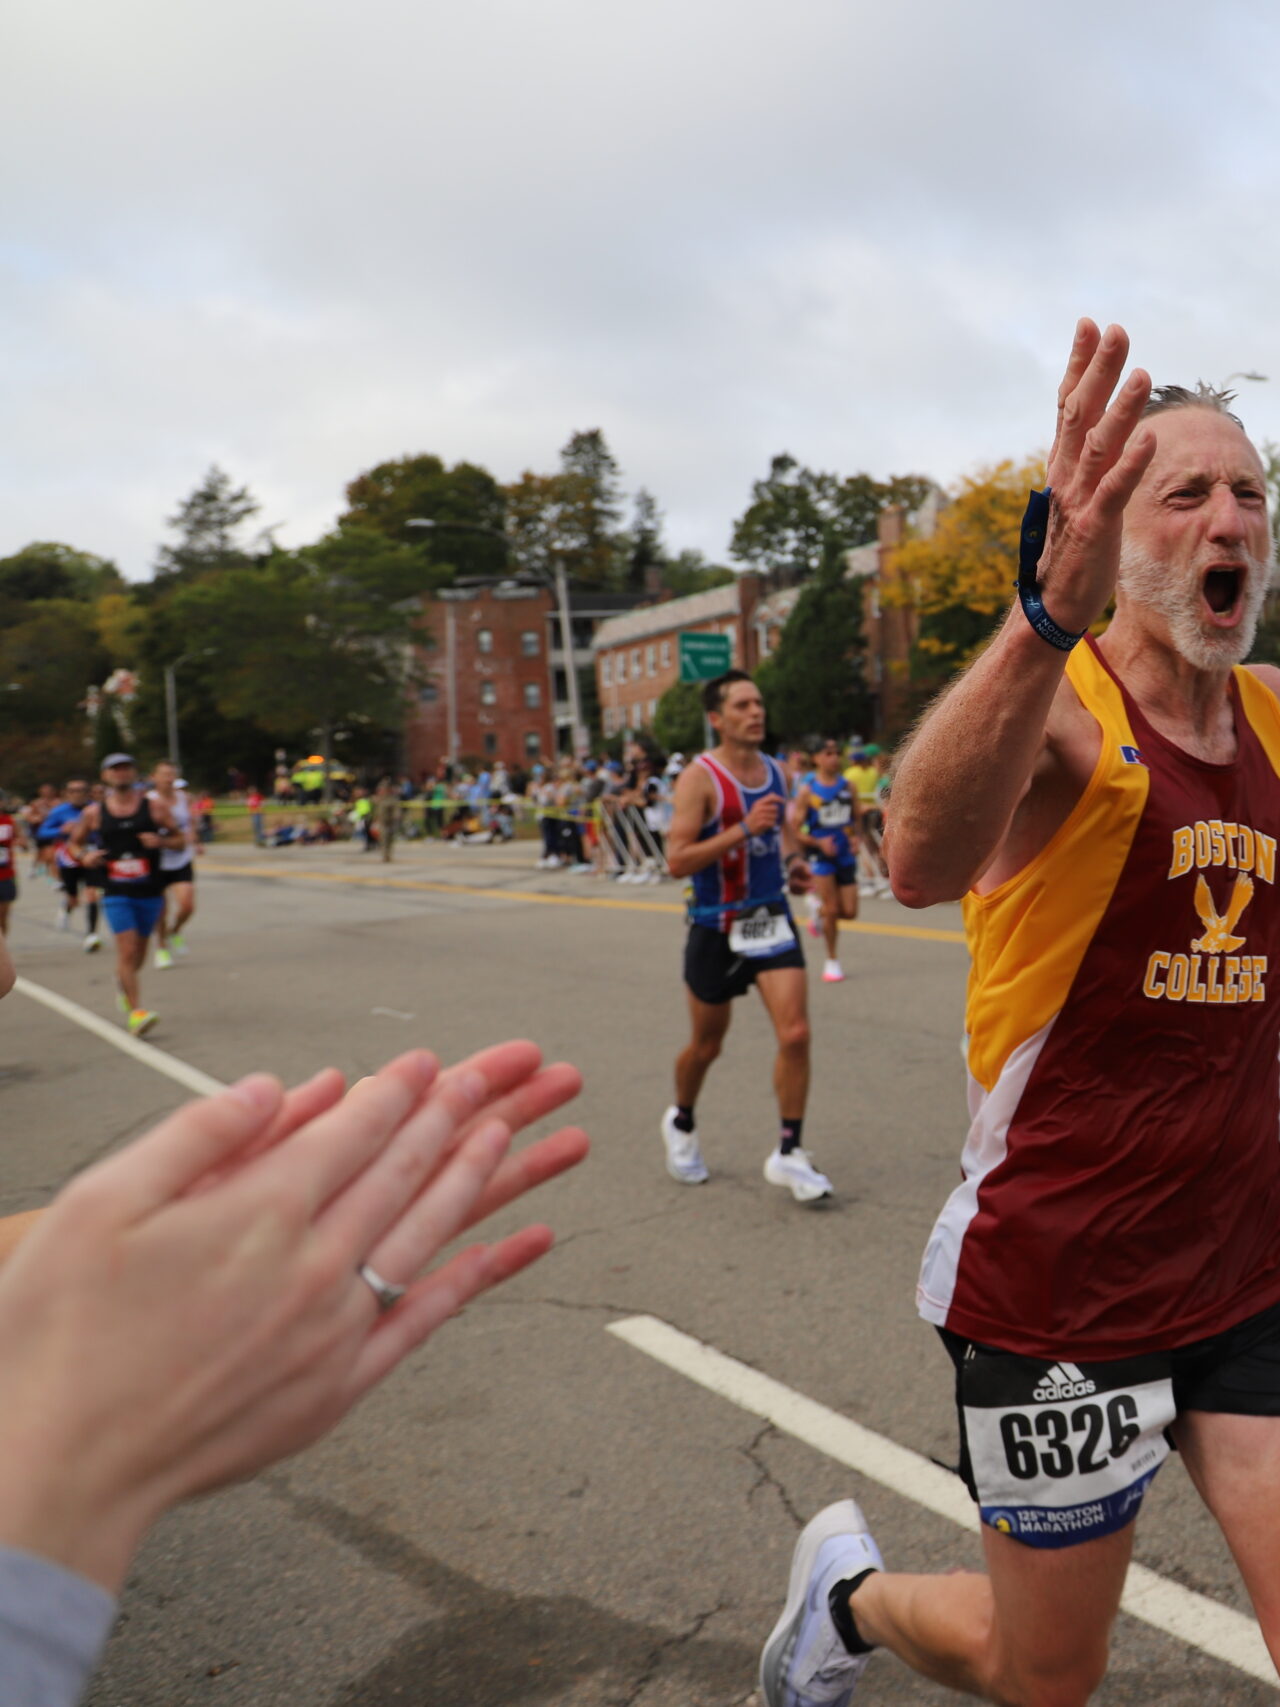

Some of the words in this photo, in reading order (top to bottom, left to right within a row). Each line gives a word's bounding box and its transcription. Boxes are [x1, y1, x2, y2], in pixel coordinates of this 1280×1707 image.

[1167, 819, 1277, 885] BOSTON
[1142, 950, 1268, 1004] COLLEGE
[1032, 1379, 1097, 1402] adidas
[1000, 1394, 1140, 1480] 6326
[1020, 1512, 1105, 1533] MARATHON
[1047, 1503, 1103, 1523] BOSTON
